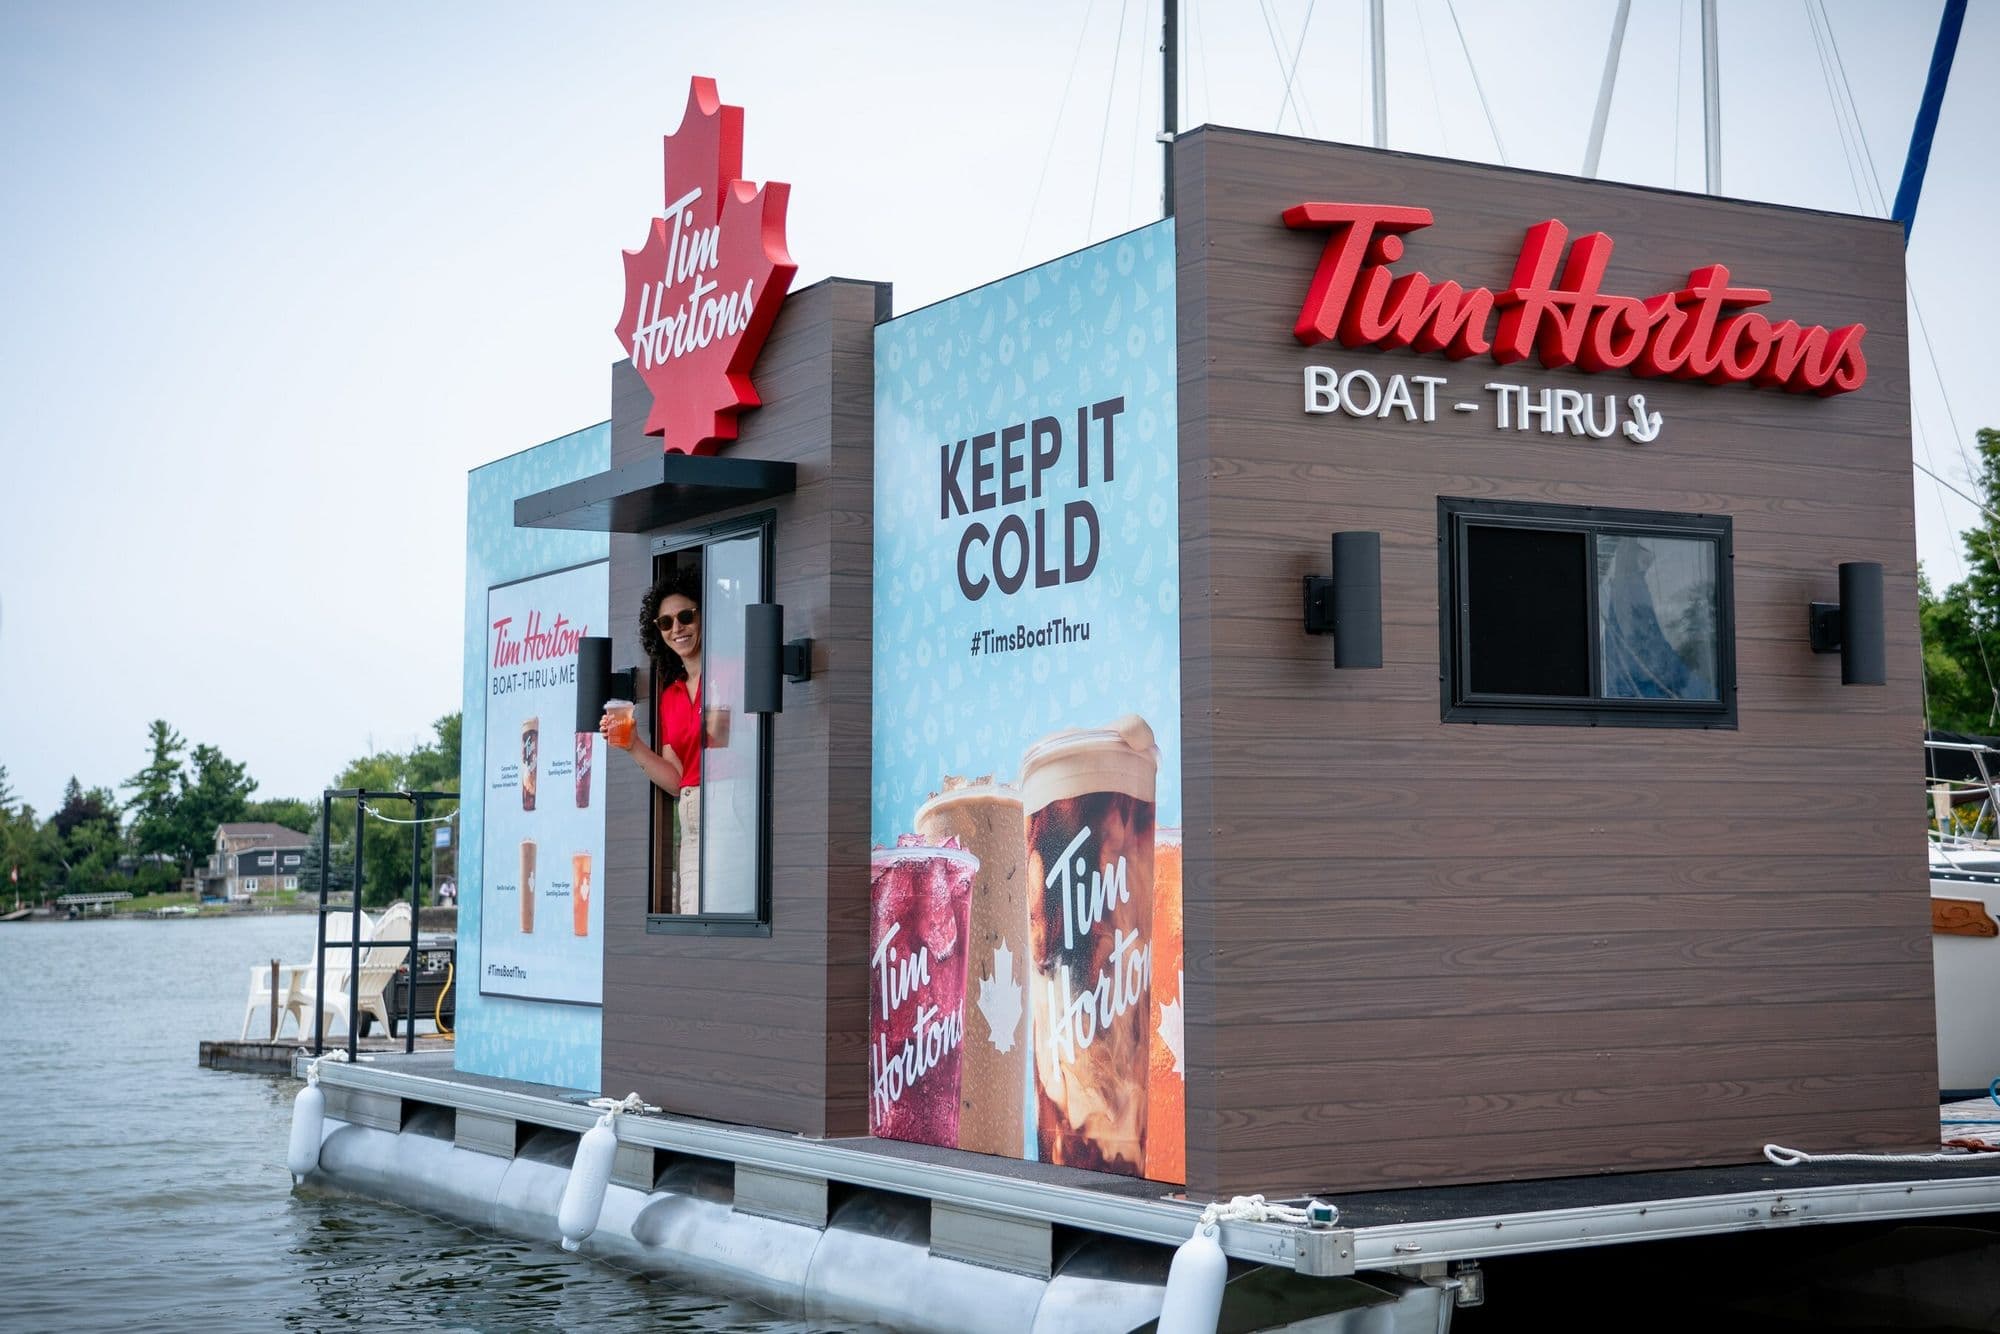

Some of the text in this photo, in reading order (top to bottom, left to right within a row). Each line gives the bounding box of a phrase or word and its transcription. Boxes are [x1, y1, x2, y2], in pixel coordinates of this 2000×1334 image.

[664, 187, 720, 288] Tim
[632, 274, 753, 370] Hortons
[1282, 202, 1868, 397] Tim Hortons
[940, 396, 1125, 520] KEEP IT
[956, 499, 1101, 602] COLD
[493, 616, 520, 669] Tim
[971, 617, 1090, 656] #TimsBoatThru
[1046, 825, 1130, 950] Tim
[872, 922, 931, 1021] Tim
[873, 998, 964, 1127] Hortons
